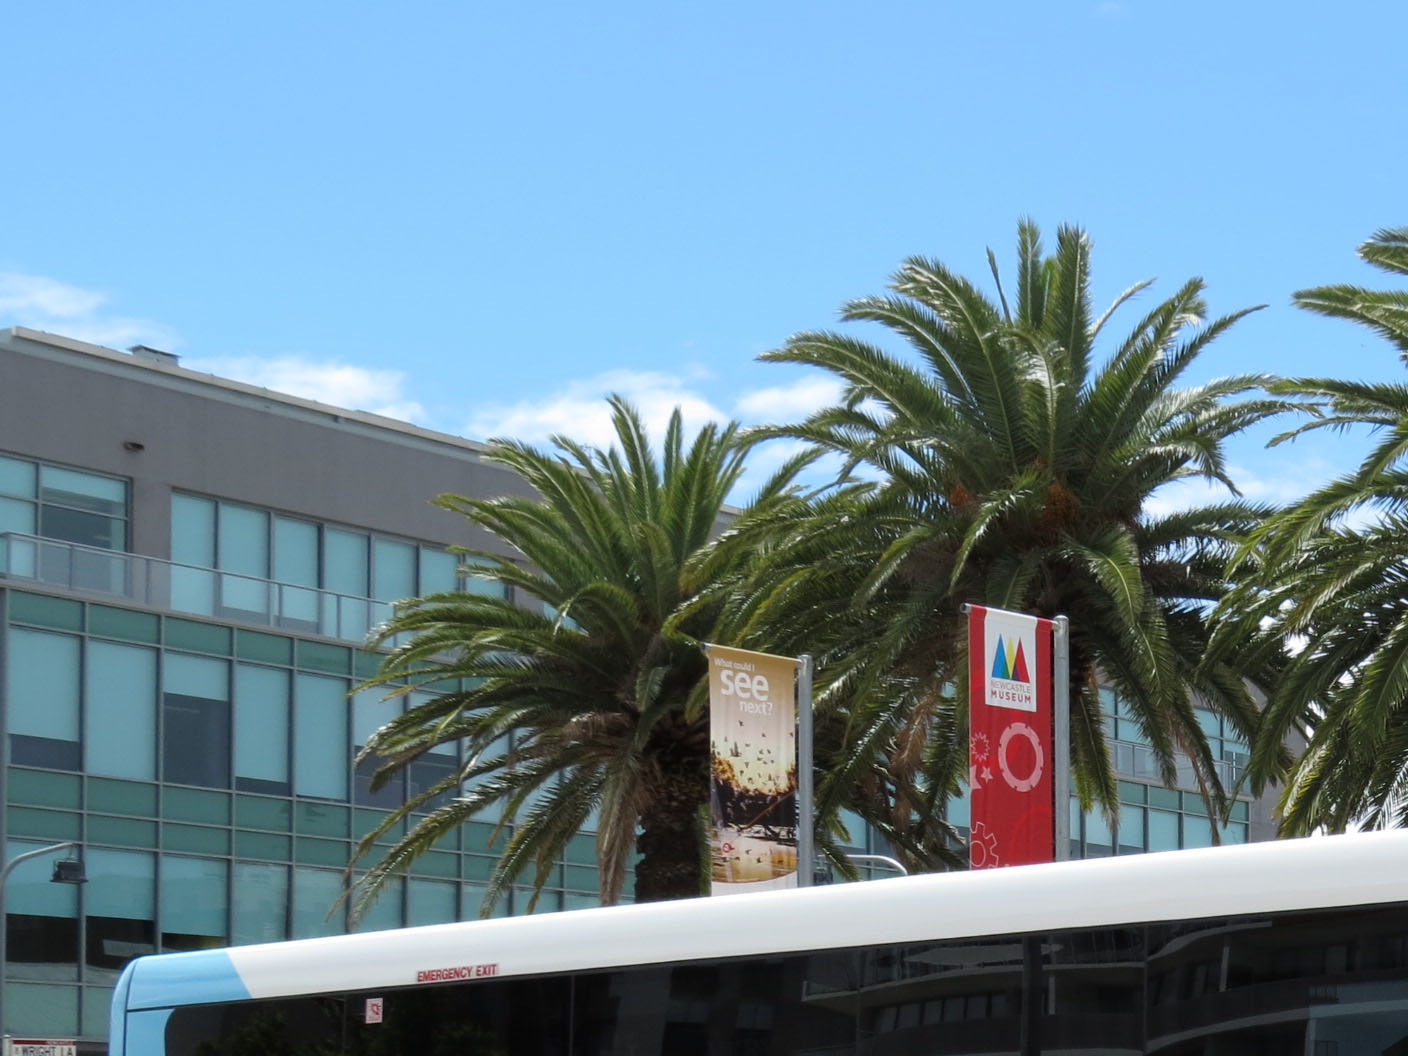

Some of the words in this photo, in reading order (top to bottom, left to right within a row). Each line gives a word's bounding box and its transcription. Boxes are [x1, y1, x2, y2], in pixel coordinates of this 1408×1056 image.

[720, 669, 769, 701] see
[991, 680, 1031, 694] NEWCASTLE
[991, 690, 1031, 704] MUSEUM
[740, 701, 773, 716] next?
[417, 966, 473, 982] EMERGENCY
[476, 963, 497, 977] EXIT
